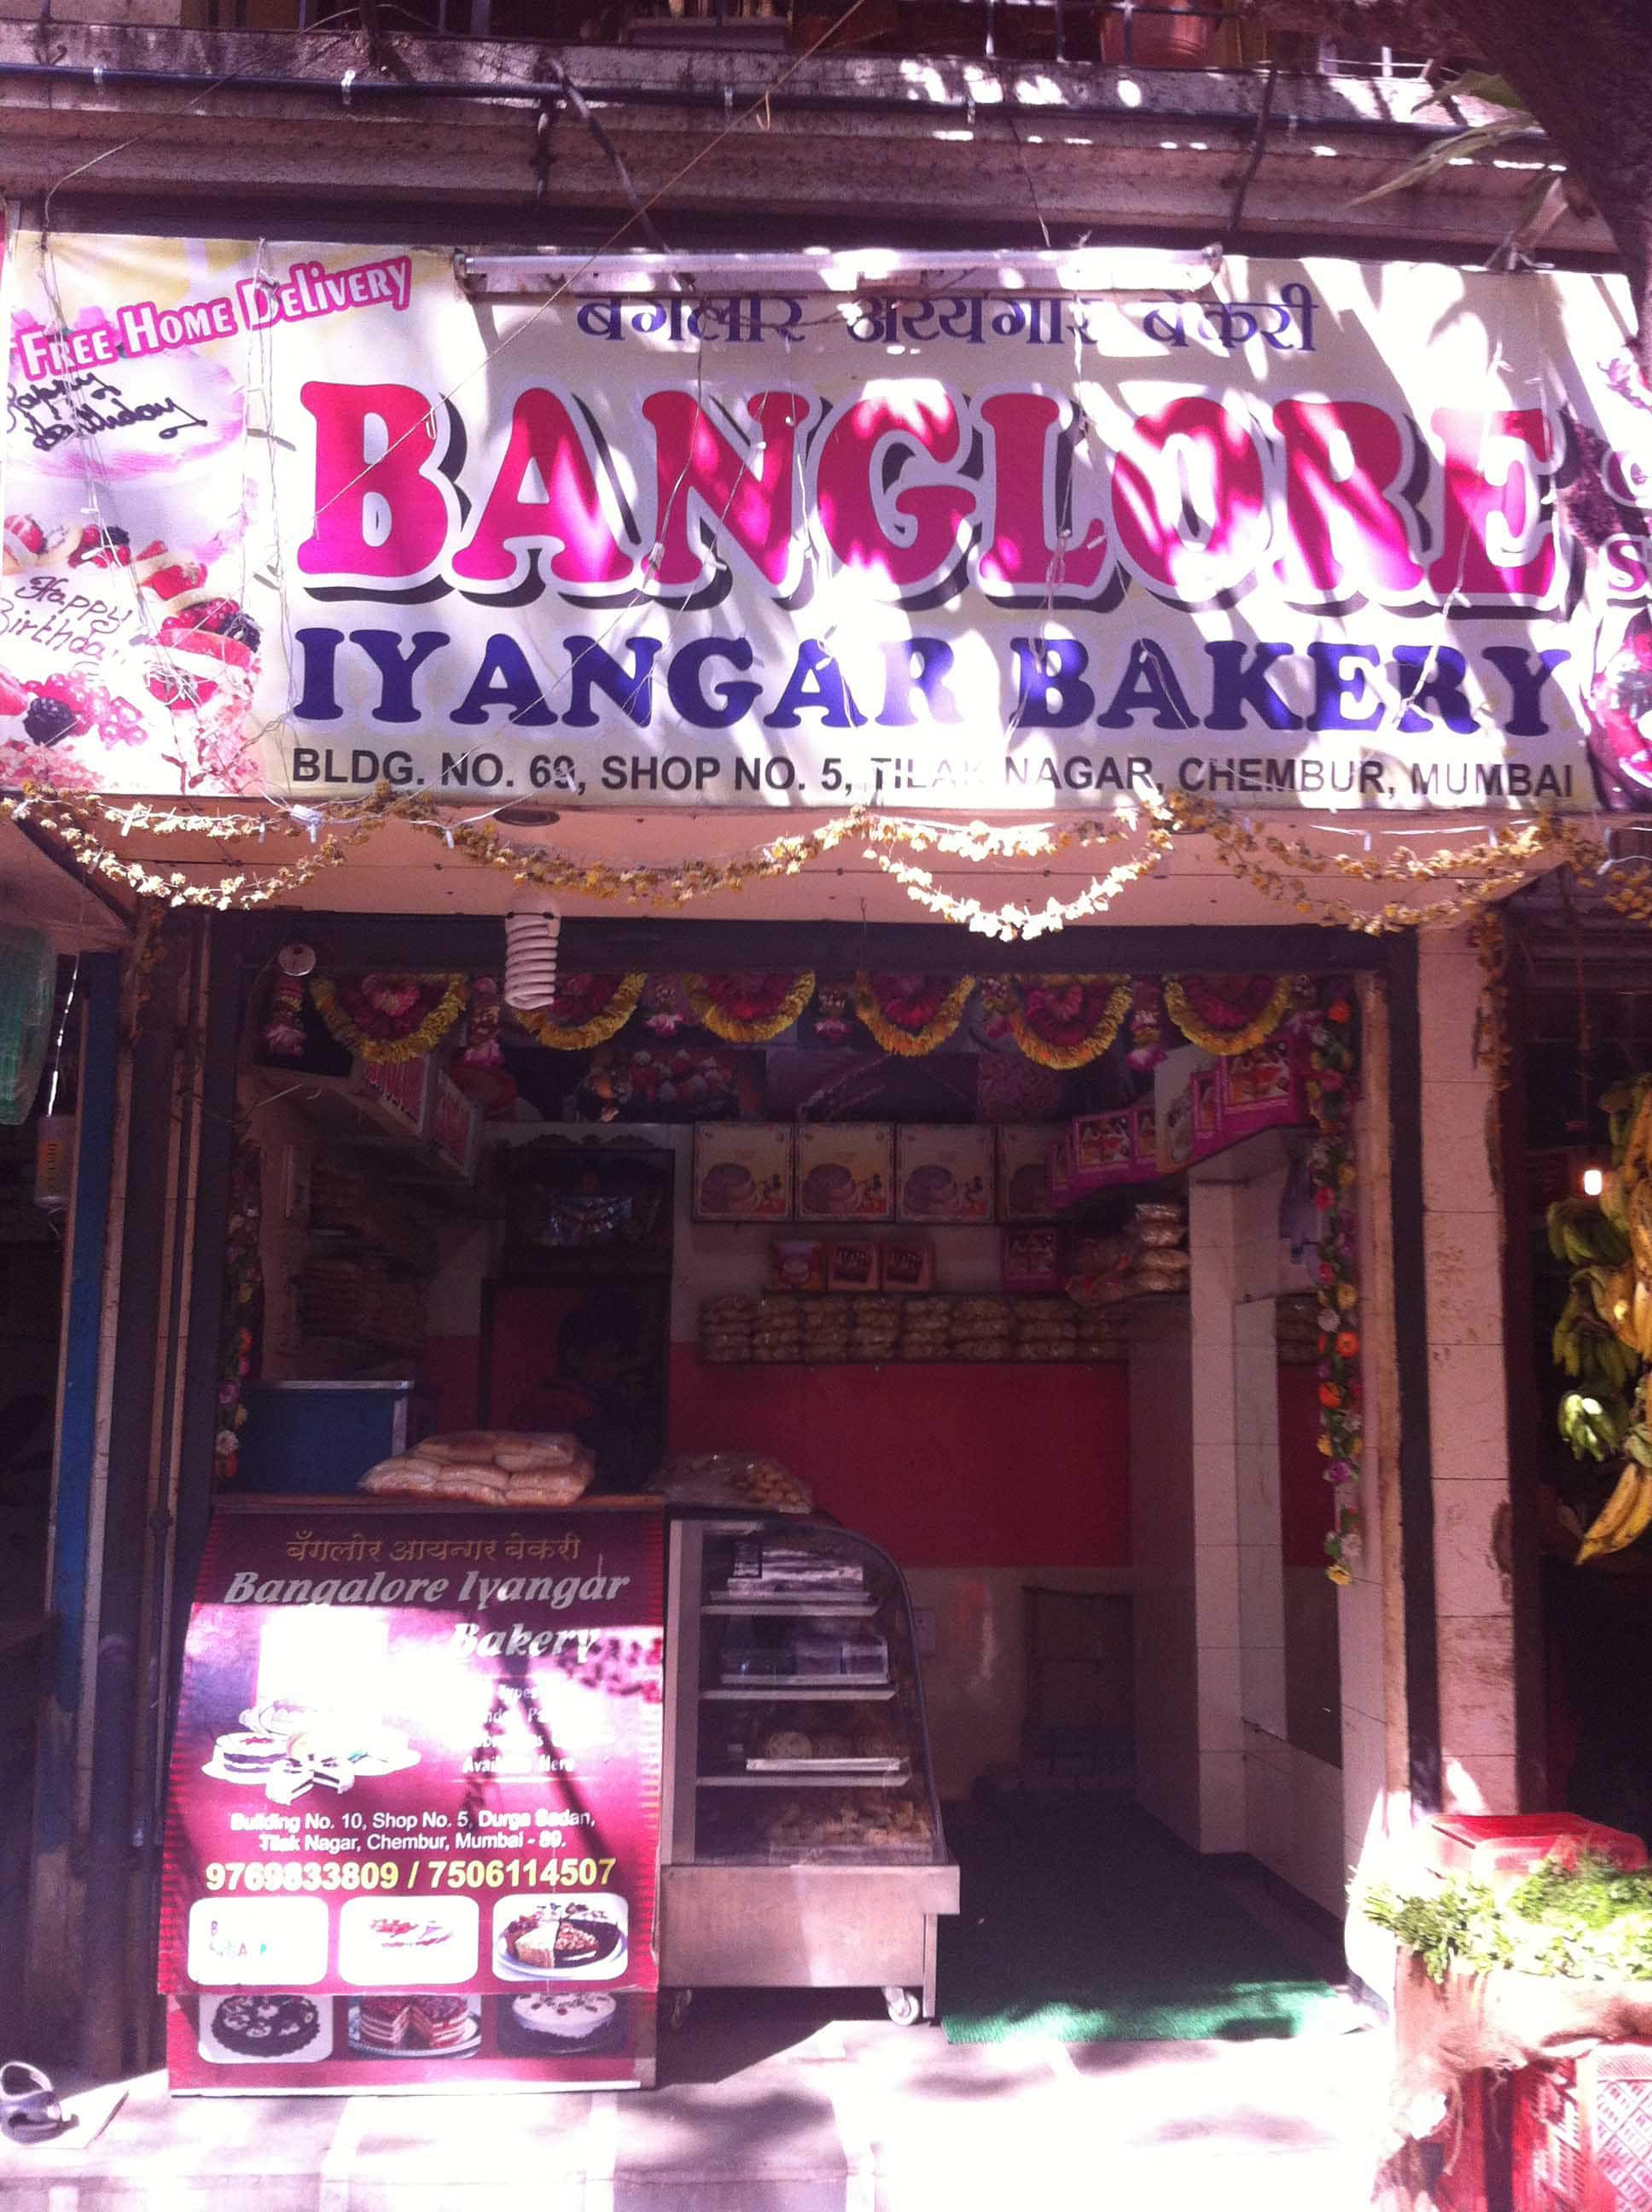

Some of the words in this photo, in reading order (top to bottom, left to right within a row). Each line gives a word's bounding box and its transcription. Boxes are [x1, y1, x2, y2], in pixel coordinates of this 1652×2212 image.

[17, 328, 117, 378] FREE
[122, 303, 236, 356] HOME
[297, 381, 1562, 602] BANGLORE
[15, 576, 133, 633] Happy
[293, 628, 966, 728] IYANGAR
[1009, 637, 1571, 736] BAKERY
[292, 748, 425, 785] BLDG.
[441, 752, 515, 787] NO.
[601, 756, 721, 790] SHOP
[734, 757, 806, 790] NO.
[820, 757, 852, 795] 5,
[1178, 757, 1396, 799] CHEMBUR,
[1411, 762, 1575, 798] MUMBAI
[223, 1571, 449, 1605] Bangalore
[450, 1621, 602, 1663] Bakery
[305, 1813, 335, 1830] No.
[341, 1813, 367, 1831] 10,
[372, 1813, 418, 1831] Shop
[422, 1811, 451, 1828] No.
[305, 1834, 362, 1854] Nagar,
[367, 1832, 451, 1852] Chembur,
[455, 1831, 524, 1849] Mumbai
[205, 1862, 399, 1891] 9769833809
[428, 1858, 616, 1889] 7506114507
